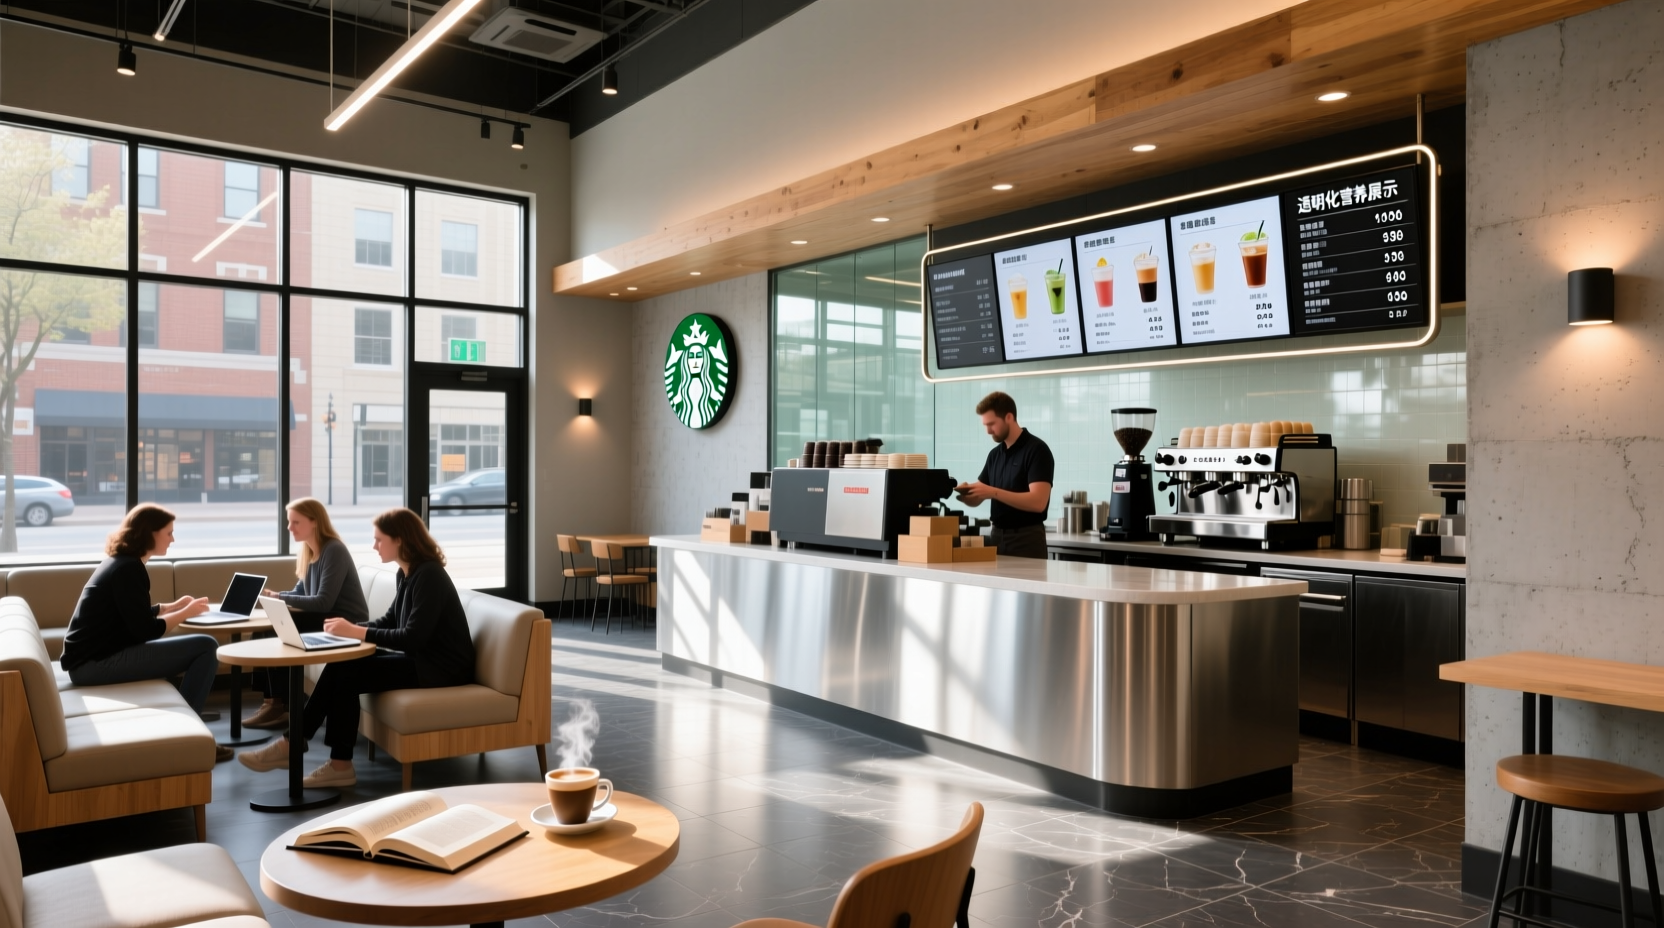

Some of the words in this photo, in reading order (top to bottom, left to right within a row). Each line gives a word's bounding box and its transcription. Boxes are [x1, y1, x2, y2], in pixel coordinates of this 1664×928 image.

[1297, 179, 1398, 214] 透明化营养展示
